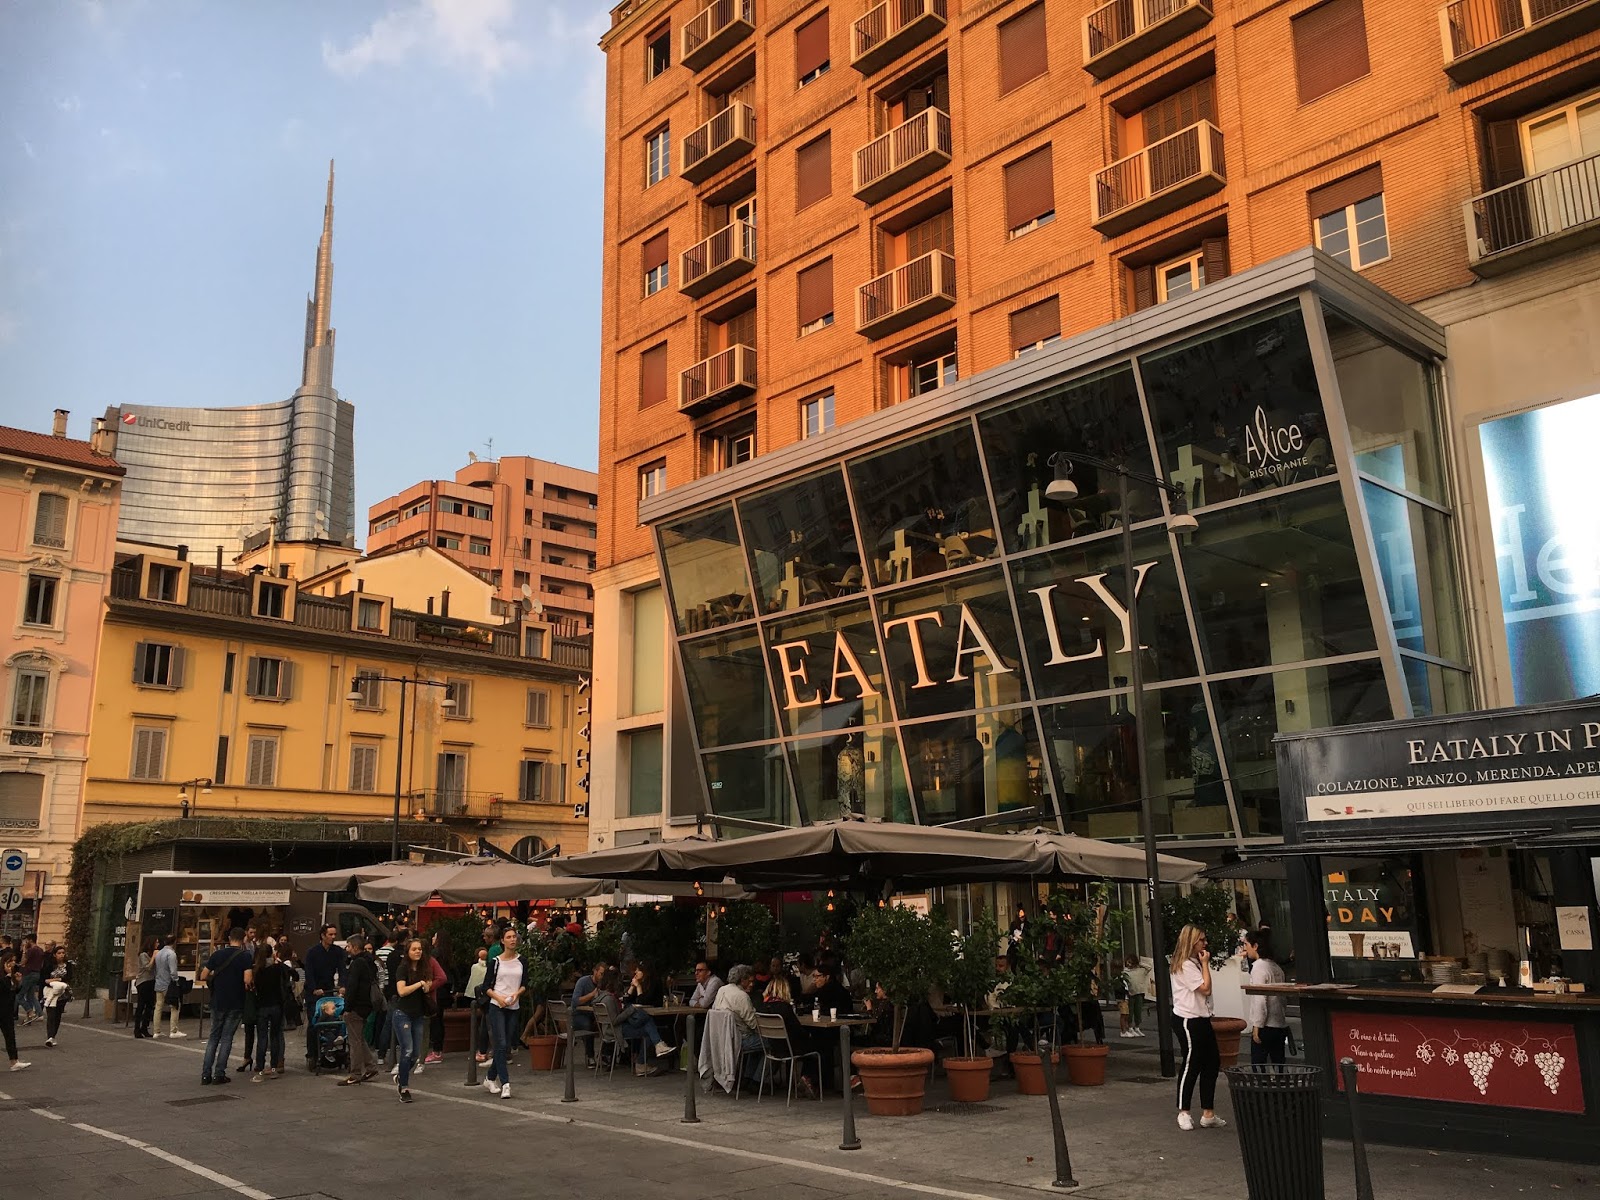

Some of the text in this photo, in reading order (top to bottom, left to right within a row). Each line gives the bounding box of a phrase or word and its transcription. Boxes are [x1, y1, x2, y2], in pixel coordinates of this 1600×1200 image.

[138, 416, 191, 431] UniCredit
[1245, 405, 1303, 468] Alice
[1249, 456, 1309, 479] RISTORANTE
[771, 561, 1158, 711] EATALY
[574, 673, 590, 819] EATALY
[1406, 733, 1529, 765] EATALY
[1534, 728, 1572, 753] IN
[1316, 760, 1600, 794] COLAZIONE, PRANZO, MERENDA, APE
[1407, 790, 1600, 812] QUI SEI LIBERO DI FARE QUELLO CHE
[1, 893, 20, 904] 30
[1325, 888, 1381, 902] TALY
[1326, 906, 1394, 923] DAY
[1349, 1029, 1360, 1040] Il
[1377, 1032, 1383, 1041] di
[1373, 1049, 1395, 1060] gustare
[1366, 1062, 1373, 1073] le
[1374, 1065, 1390, 1075] nostre
[1390, 1066, 1417, 1079] proposte!
